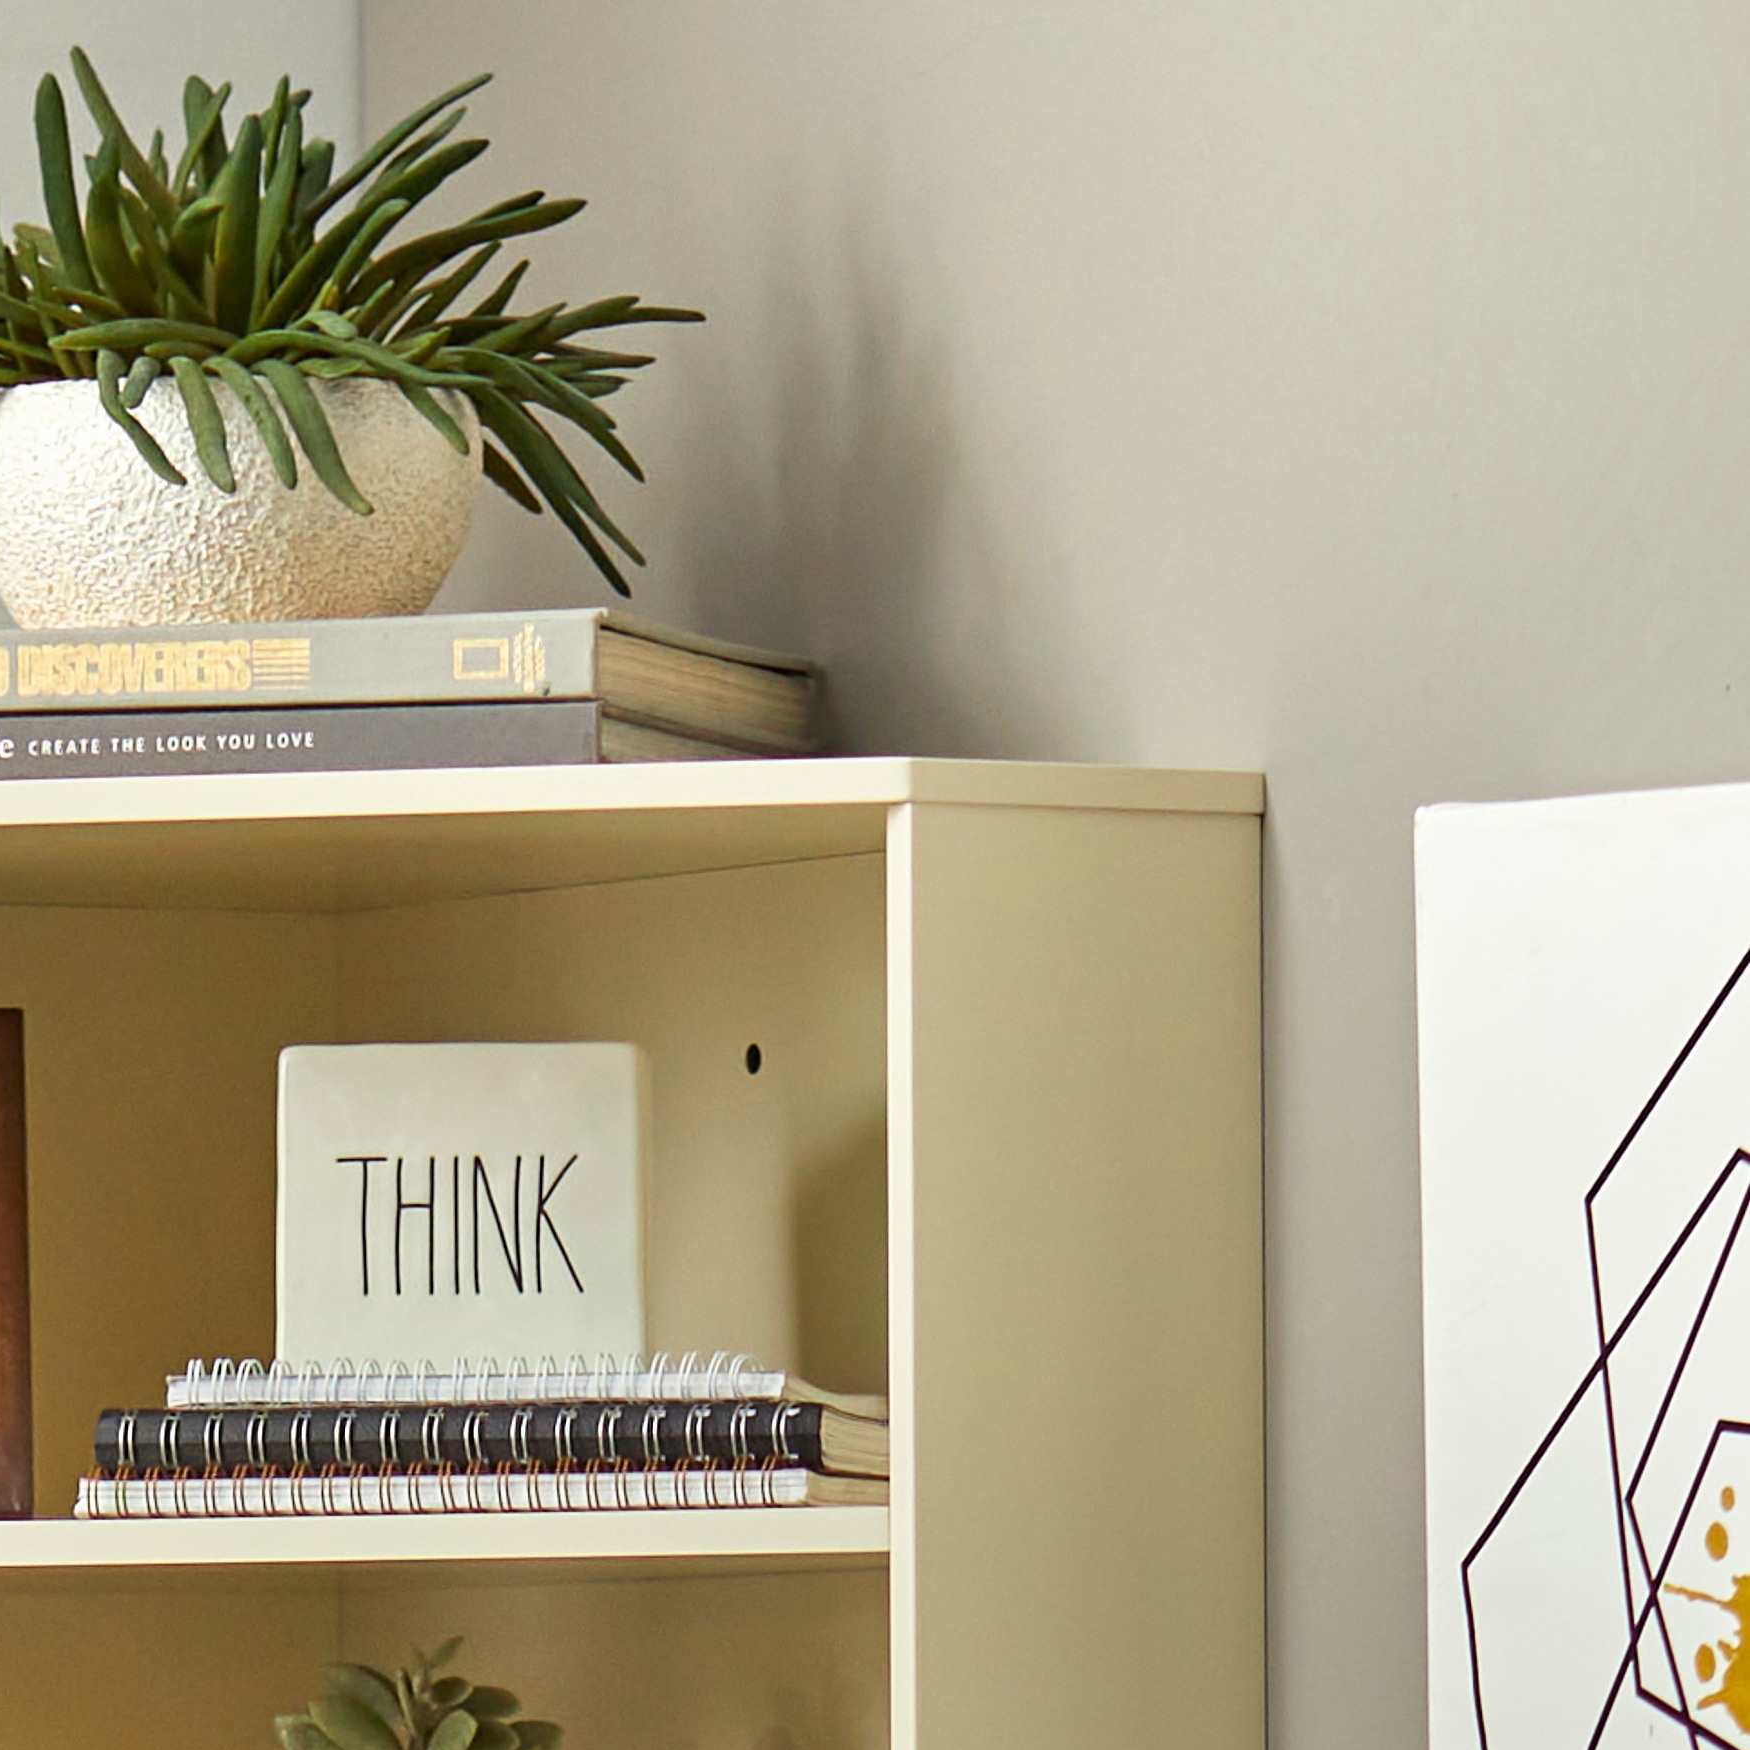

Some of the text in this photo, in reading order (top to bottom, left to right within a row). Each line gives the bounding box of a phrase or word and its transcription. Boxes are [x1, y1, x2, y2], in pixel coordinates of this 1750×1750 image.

[17, 639, 251, 698] DISCOVERERS
[27, 731, 316, 757] CREATE THE LOOK YOU LOVE
[335, 1154, 585, 1296] THINK
